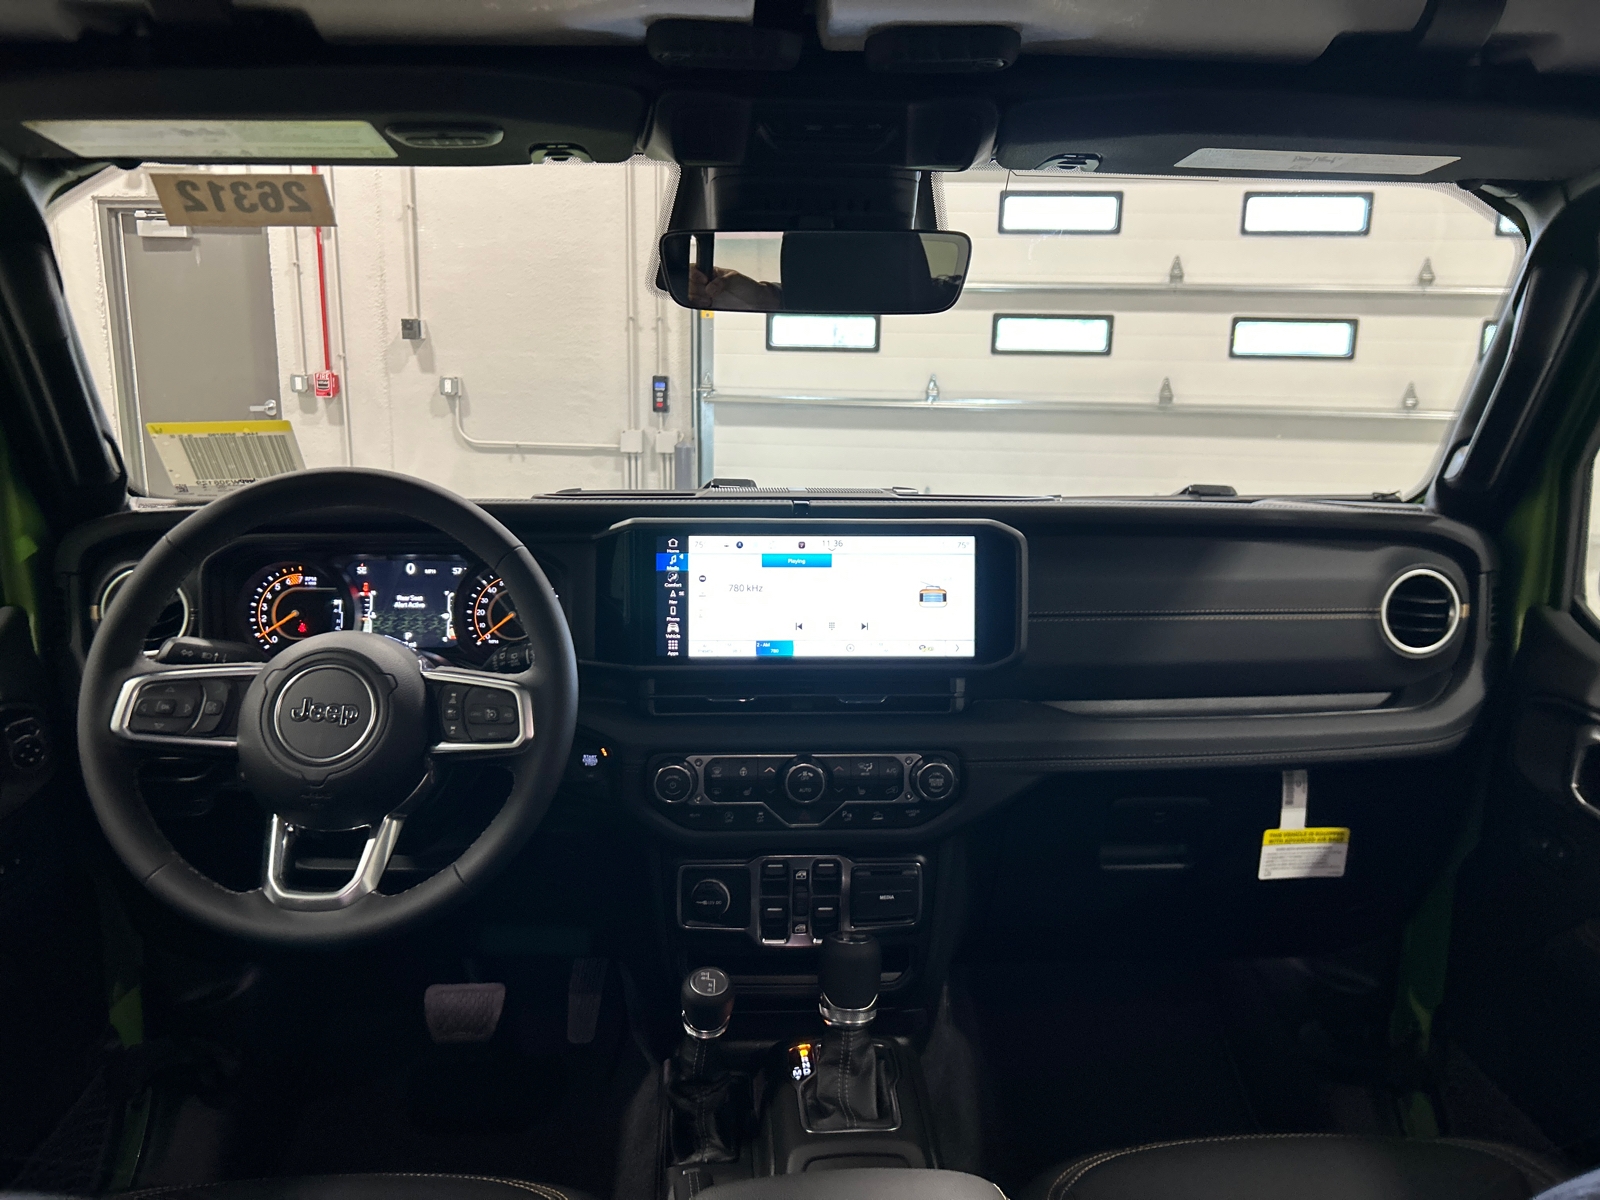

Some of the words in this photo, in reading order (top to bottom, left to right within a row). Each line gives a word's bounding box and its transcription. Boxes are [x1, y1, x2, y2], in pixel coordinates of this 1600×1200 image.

[822, 539, 844, 548] 1136
[405, 562, 416, 575] 0
[274, 583, 281, 591] 5
[728, 584, 745, 592] 780
[746, 583, 764, 592] kHz
[266, 591, 272, 600] 4
[261, 603, 268, 611] 3
[261, 615, 267, 623] 2
[271, 635, 278, 643] 0
[404, 631, 413, 640] P
[290, 697, 360, 727] Jeep
